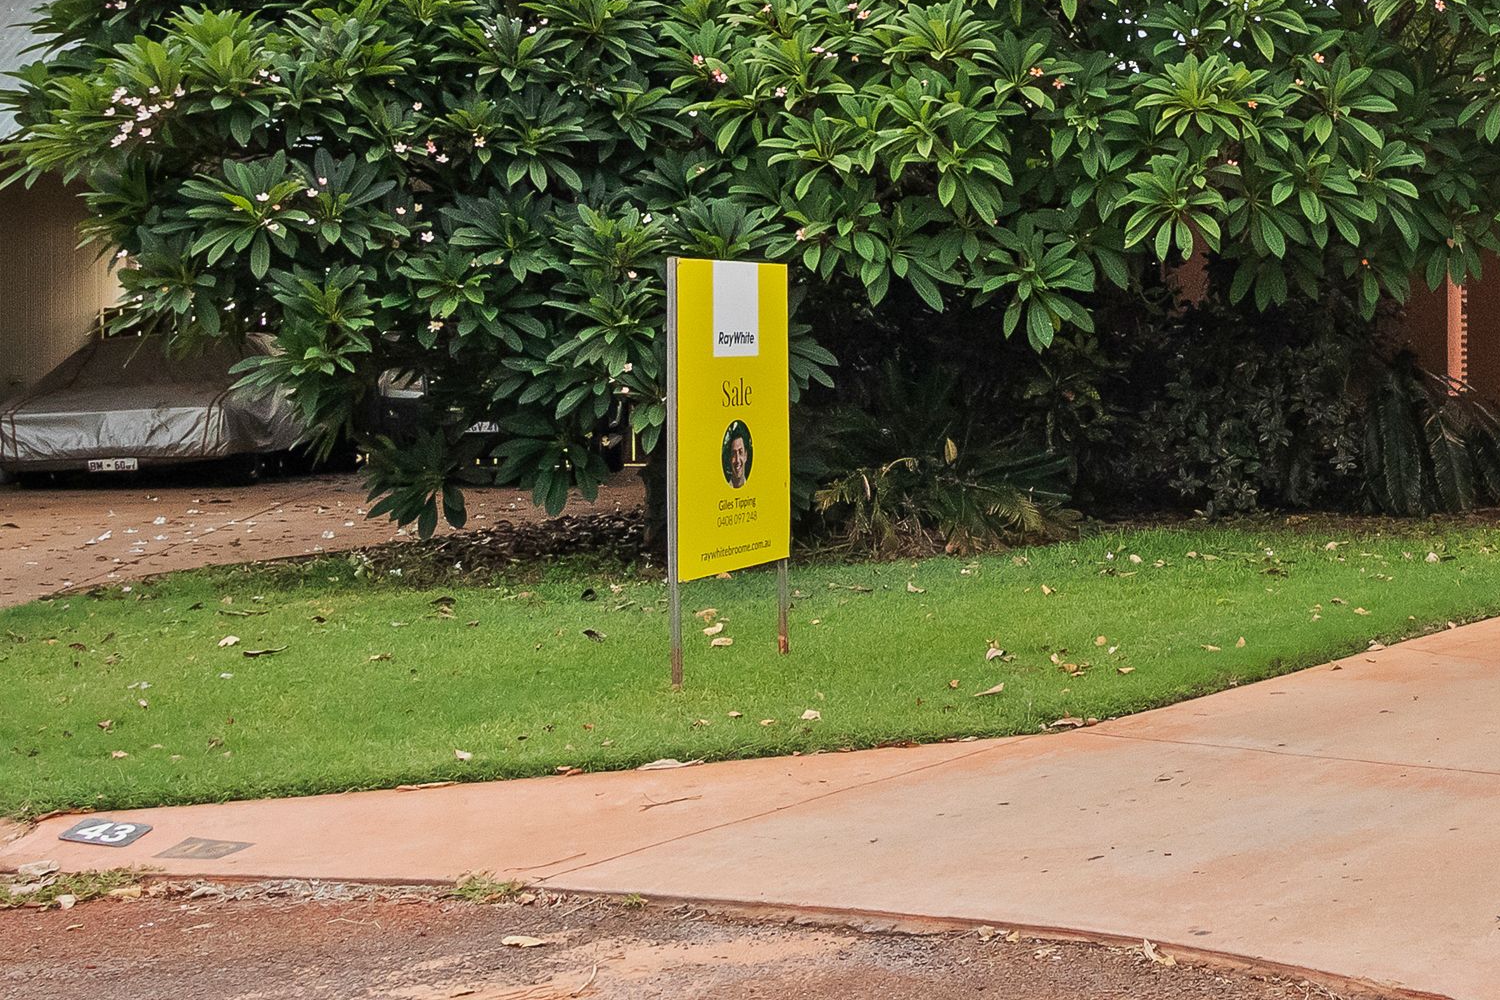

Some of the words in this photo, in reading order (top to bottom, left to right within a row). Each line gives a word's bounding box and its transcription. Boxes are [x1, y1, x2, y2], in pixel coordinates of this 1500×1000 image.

[722, 377, 753, 408] Sale
[735, 496, 757, 509] Tipping
[701, 539, 771, 562] raywhitebroome.com.au
[76, 822, 136, 843] 43
